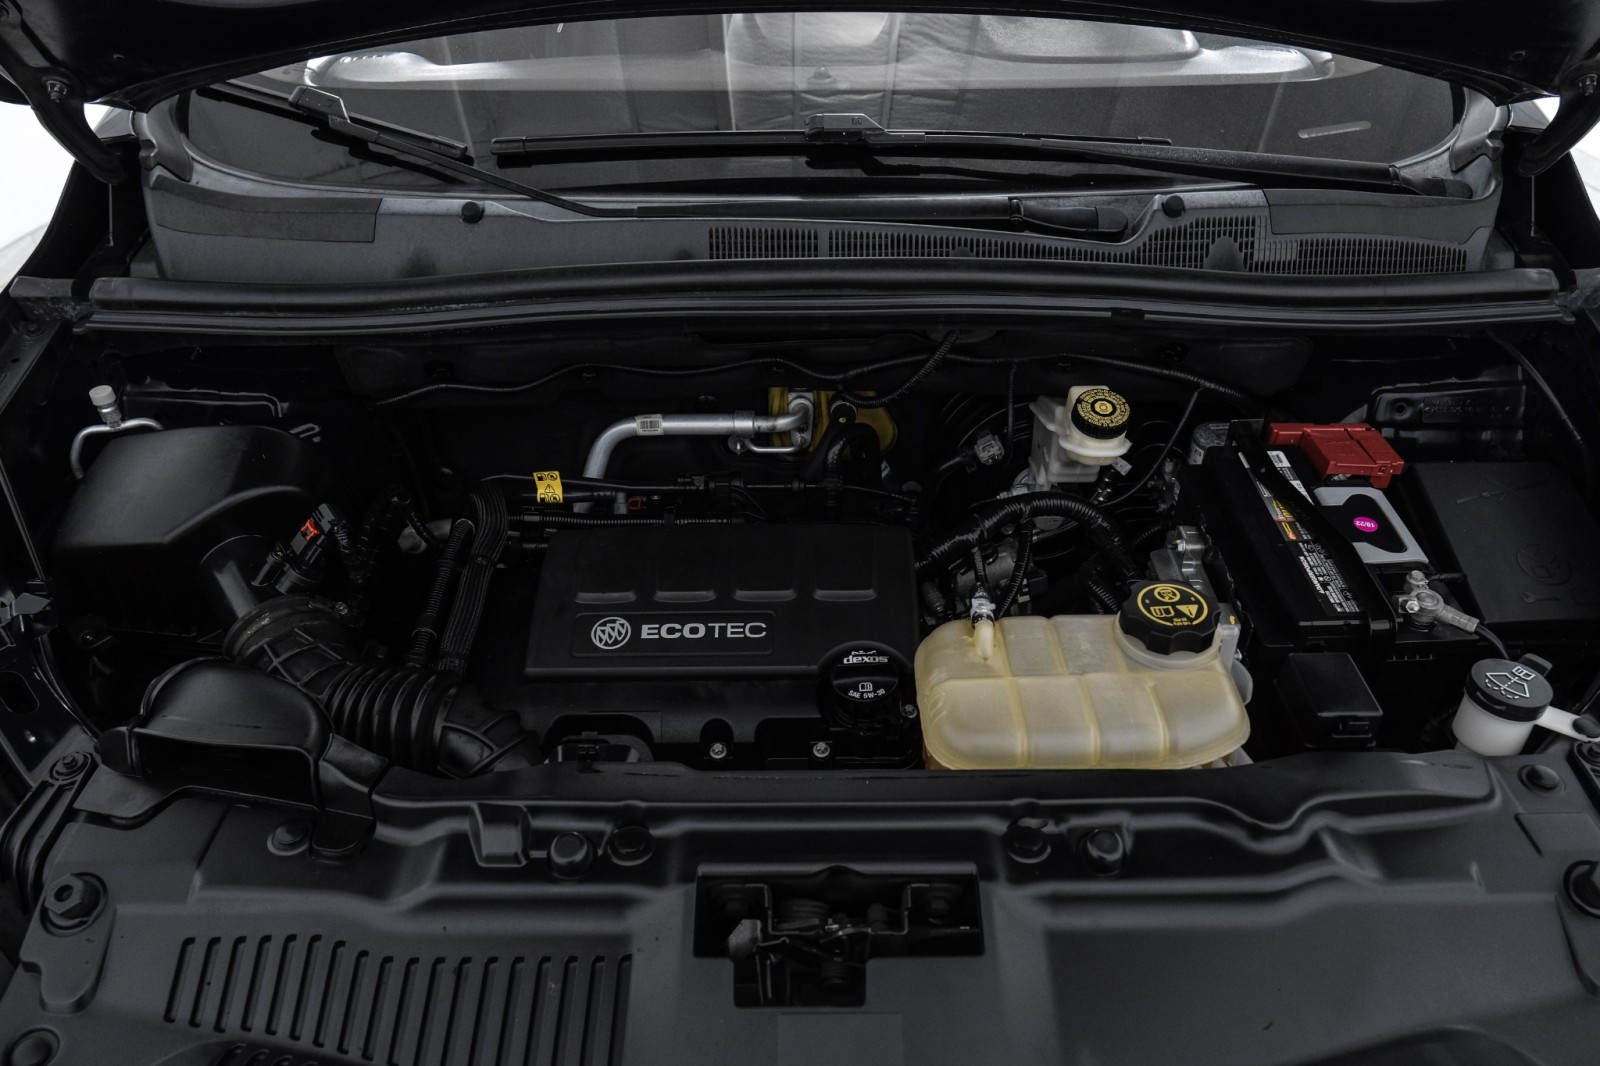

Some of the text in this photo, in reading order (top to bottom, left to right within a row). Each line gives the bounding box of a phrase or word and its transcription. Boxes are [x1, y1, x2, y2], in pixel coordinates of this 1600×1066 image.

[640, 622, 767, 639] ECOTEC
[843, 655, 889, 664] dexos
[848, 688, 886, 699] SAE 5W-30
